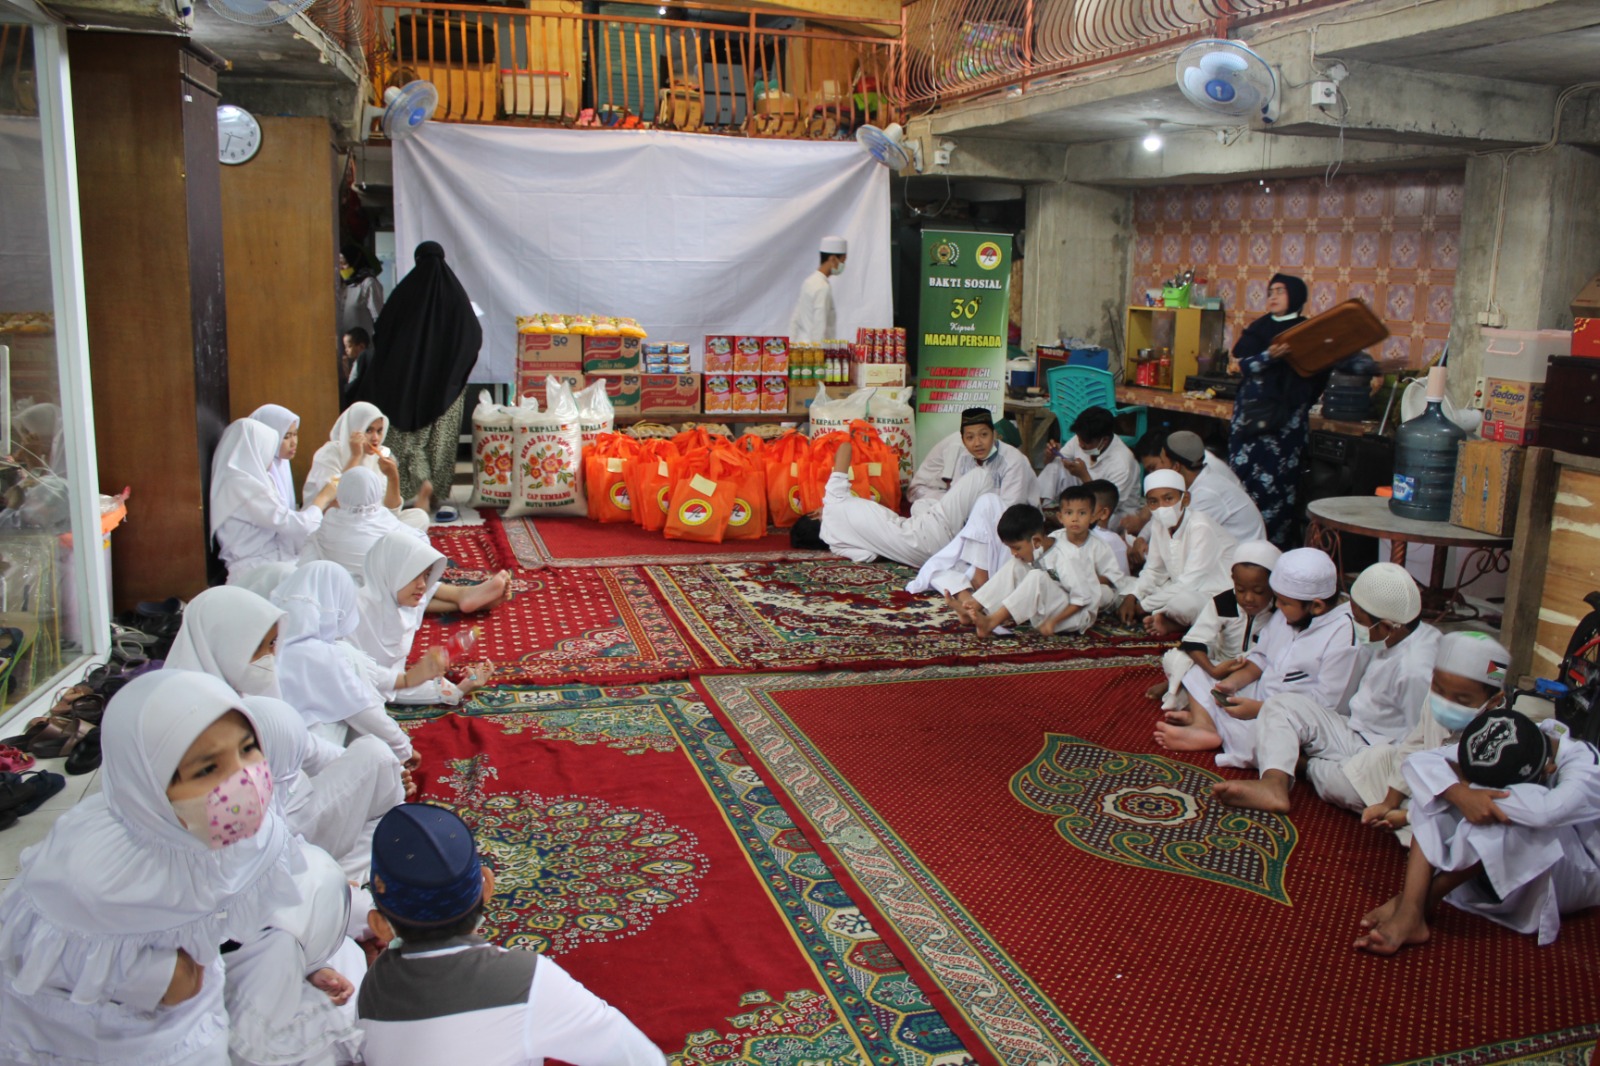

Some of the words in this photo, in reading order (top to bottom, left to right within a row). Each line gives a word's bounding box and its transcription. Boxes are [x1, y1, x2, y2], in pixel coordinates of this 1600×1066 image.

[929, 277, 962, 288] BAKTI
[964, 278, 1002, 289] SOSIAL
[950, 322, 976, 334] Kiprah
[553, 336, 568, 347] 50
[624, 338, 638, 348] 50
[924, 334, 958, 346] MACAN
[960, 335, 1002, 347] PERSADA
[969, 368, 990, 378] KECIL
[624, 376, 638, 386] 50
[680, 376, 694, 386] 50
[920, 379, 947, 389] UNTUK
[930, 391, 972, 400] MENGABDI
[973, 392, 990, 401] DAN
[1490, 389, 1525, 402] Sedaap
[919, 403, 964, 412] MEMBANTU
[816, 418, 842, 426] KEPALA
[876, 417, 904, 425] KEPALA
[528, 425, 560, 433] KEPALA
[490, 434, 510, 442] SLYP
[537, 434, 556, 442] SLYP
[482, 488, 493, 496] CAP
